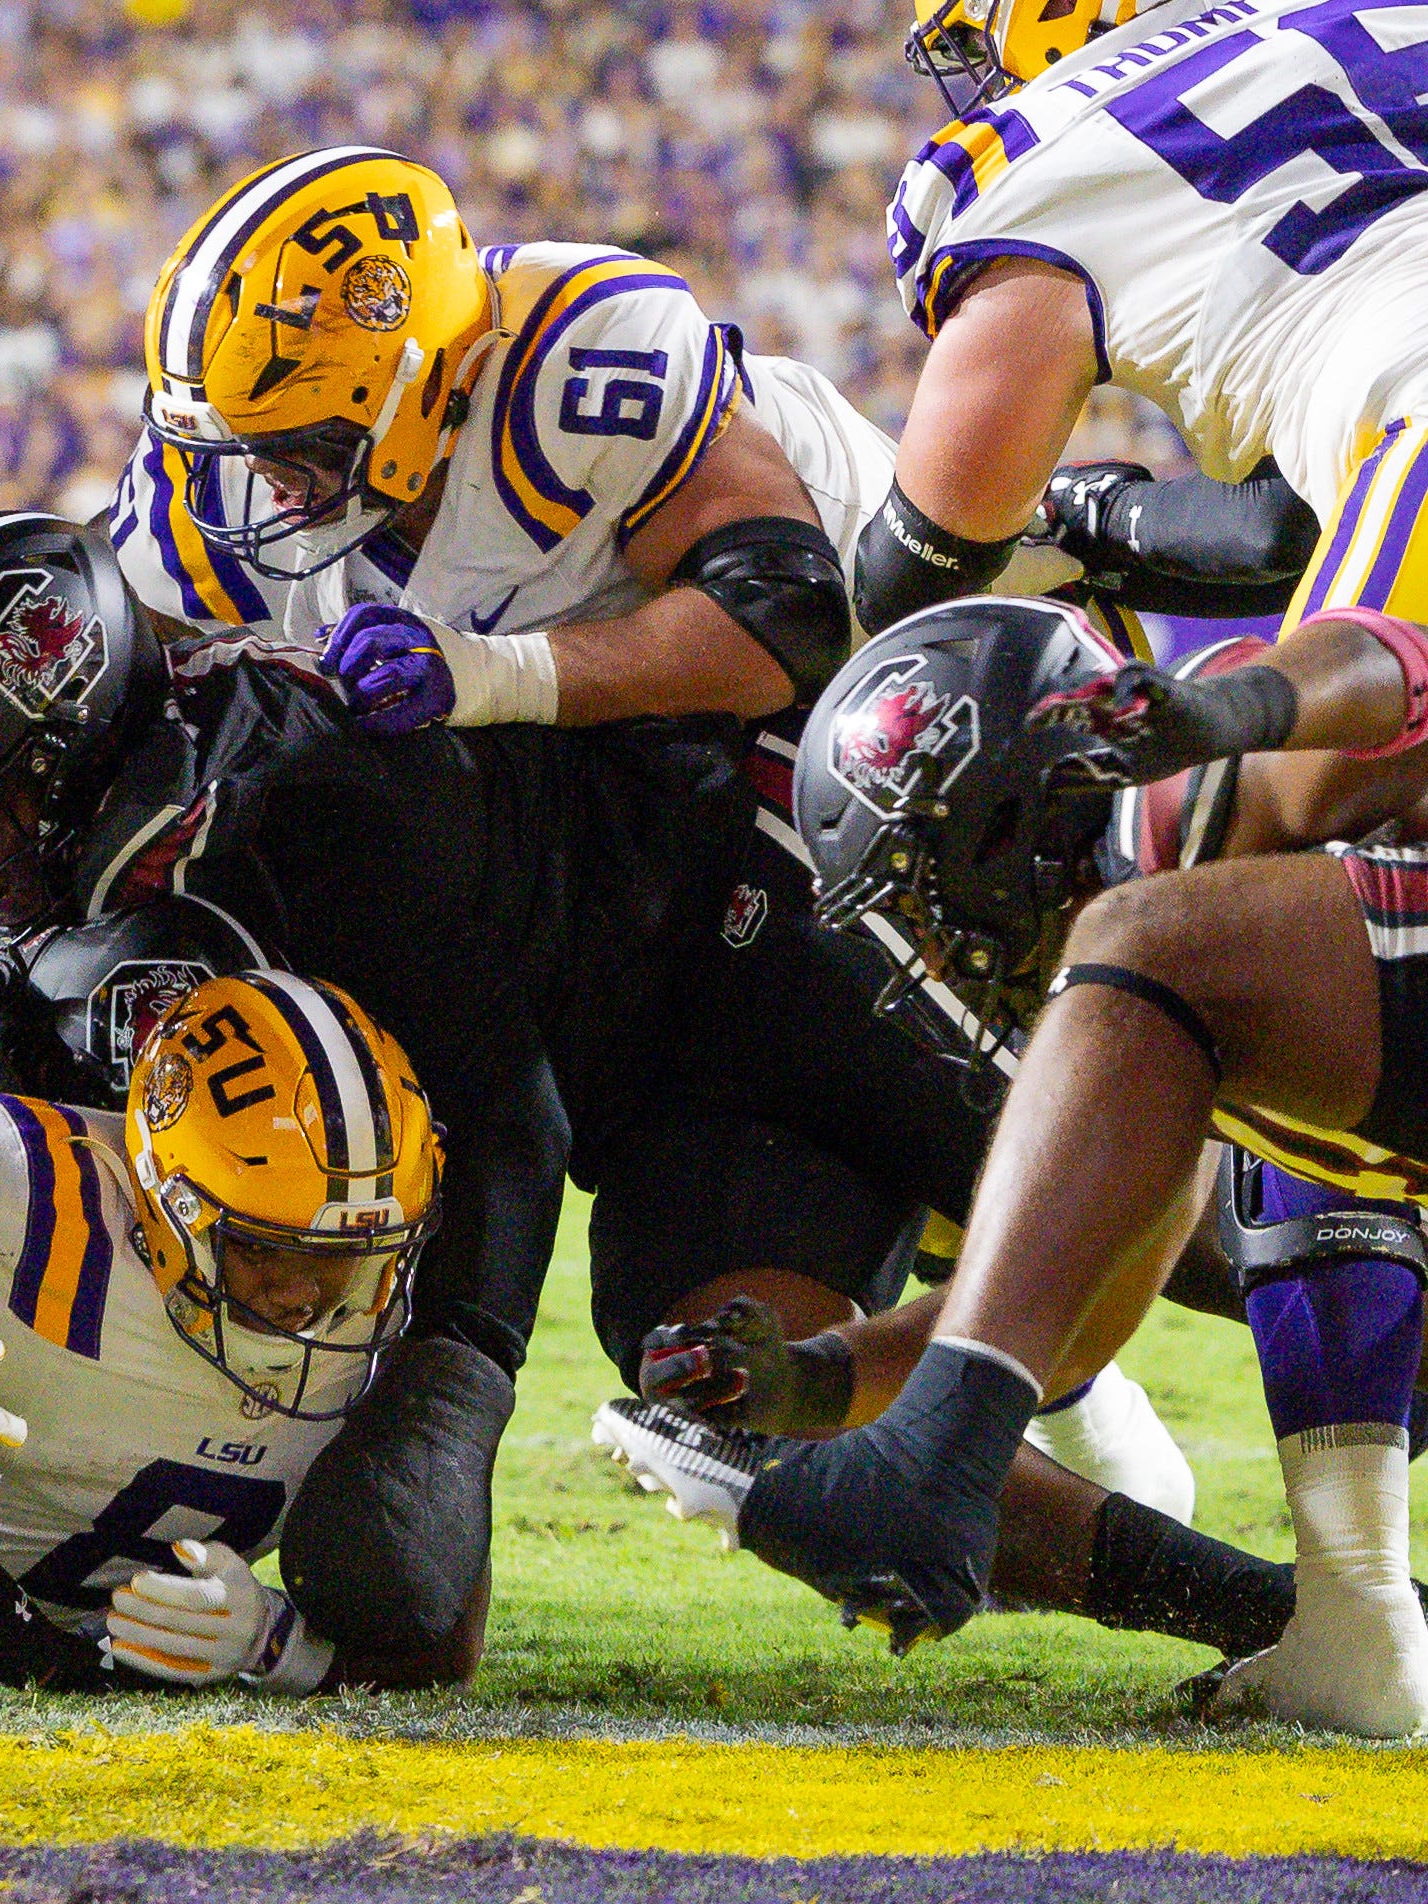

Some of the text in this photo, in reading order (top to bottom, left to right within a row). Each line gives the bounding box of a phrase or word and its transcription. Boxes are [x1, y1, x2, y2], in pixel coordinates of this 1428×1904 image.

[558, 346, 669, 441] 61
[339, 1207, 390, 1230] LSU
[1316, 1227, 1407, 1243] DONJOY
[196, 1436, 268, 1465] LSU
